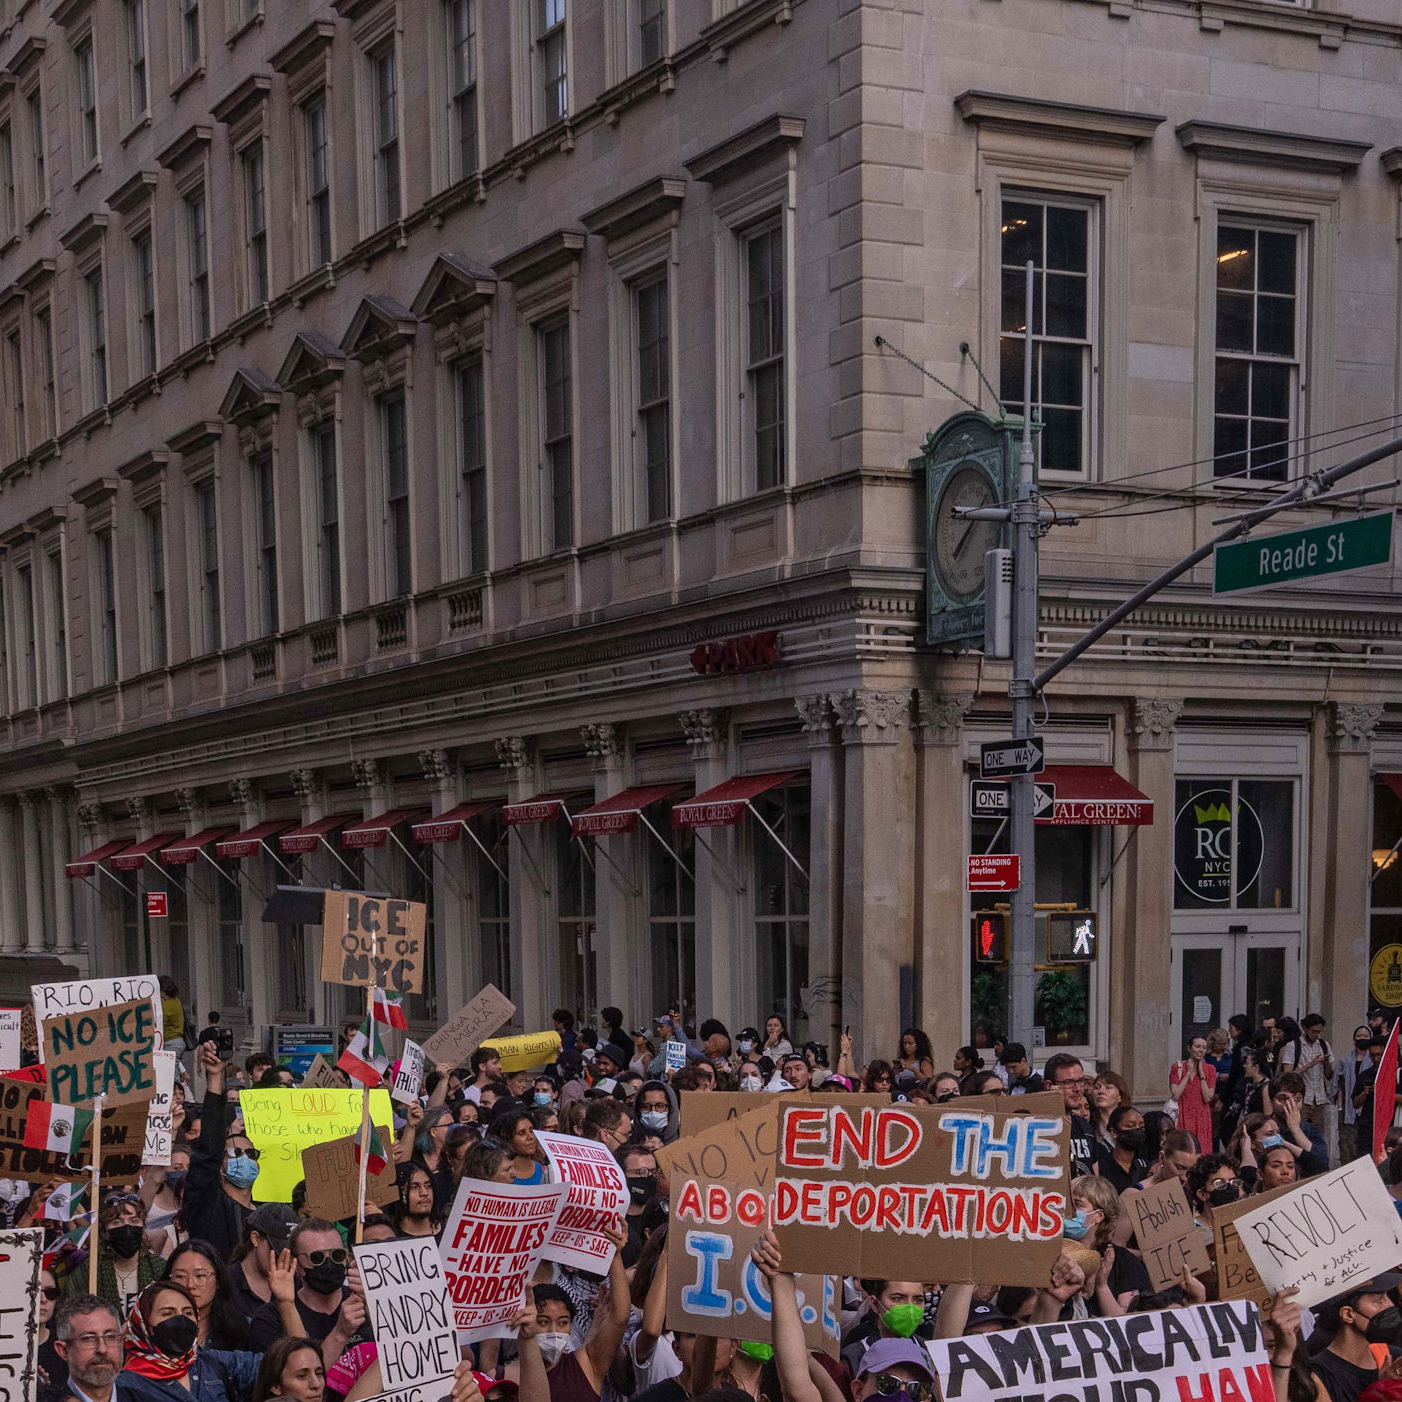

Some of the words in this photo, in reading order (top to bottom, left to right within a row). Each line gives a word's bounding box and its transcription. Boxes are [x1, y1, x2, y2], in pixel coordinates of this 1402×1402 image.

[1259, 541, 1317, 576] Reade
[1327, 531, 1345, 563] St
[710, 631, 780, 671] PARK
[986, 751, 1004, 766] ONE
[1014, 748, 1035, 764] WAY
[679, 808, 703, 823] ROYAL
[706, 804, 733, 821] GREEN
[979, 791, 1004, 806] ONE
[1090, 802, 1137, 819] GREEN
[970, 859, 979, 867] NO
[980, 858, 1011, 867] STANDING
[970, 867, 996, 876] Anytime
[1205, 862, 1230, 873] NYC
[347, 897, 409, 936] ICE
[341, 933, 387, 955] OUT
[395, 939, 419, 955] OF
[342, 954, 416, 993] NYC
[44, 985, 94, 1009] RIO
[113, 979, 155, 1003] RIO
[1385, 991, 1402, 1001] SHOP
[51, 1016, 97, 1055] NO
[429, 1014, 470, 1052] CHINGA
[475, 997, 492, 1015] LA
[453, 1008, 495, 1048] MIGRA
[524, 1037, 556, 1053] RIGHTS!!
[50, 1050, 153, 1104] PLEASE
[396, 1071, 417, 1096] THIS
[239, 1091, 282, 1122] Being
[290, 1093, 336, 1112] LOUD
[247, 1116, 289, 1137] those
[298, 1123, 323, 1136] who
[330, 1121, 358, 1136] have
[558, 1144, 579, 1158] HUMAN
[781, 1106, 923, 1169] END
[939, 1112, 1065, 1180] THE
[556, 1158, 623, 1192] FAMILIES
[464, 1196, 481, 1212] NO
[483, 1199, 517, 1217] HUMAN
[518, 1200, 528, 1217] IS
[527, 1197, 558, 1215] ILLEGAL
[568, 1186, 598, 1206] HAVE
[601, 1190, 617, 1209] NO
[774, 1177, 1067, 1241] DEPORTATIONS
[1135, 1198, 1184, 1230] Abolish
[1251, 1169, 1368, 1268] REVOLT
[451, 1220, 549, 1254] FAMILIES
[549, 1229, 570, 1245] KEEP
[575, 1234, 586, 1248] US
[589, 1238, 612, 1255] SAFE
[360, 1245, 440, 1291] BRING
[458, 1254, 505, 1273] HAVE
[511, 1253, 528, 1272] NO
[1150, 1238, 1196, 1285] ICE
[1333, 1238, 1373, 1269] Justice
[444, 1270, 529, 1305] BORDERS
[375, 1287, 448, 1342] ANDRY
[453, 1309, 477, 1326] KEEP
[482, 1307, 494, 1323] US
[383, 1329, 461, 1384] HOME!
[946, 1306, 1201, 1399] AMERICA
